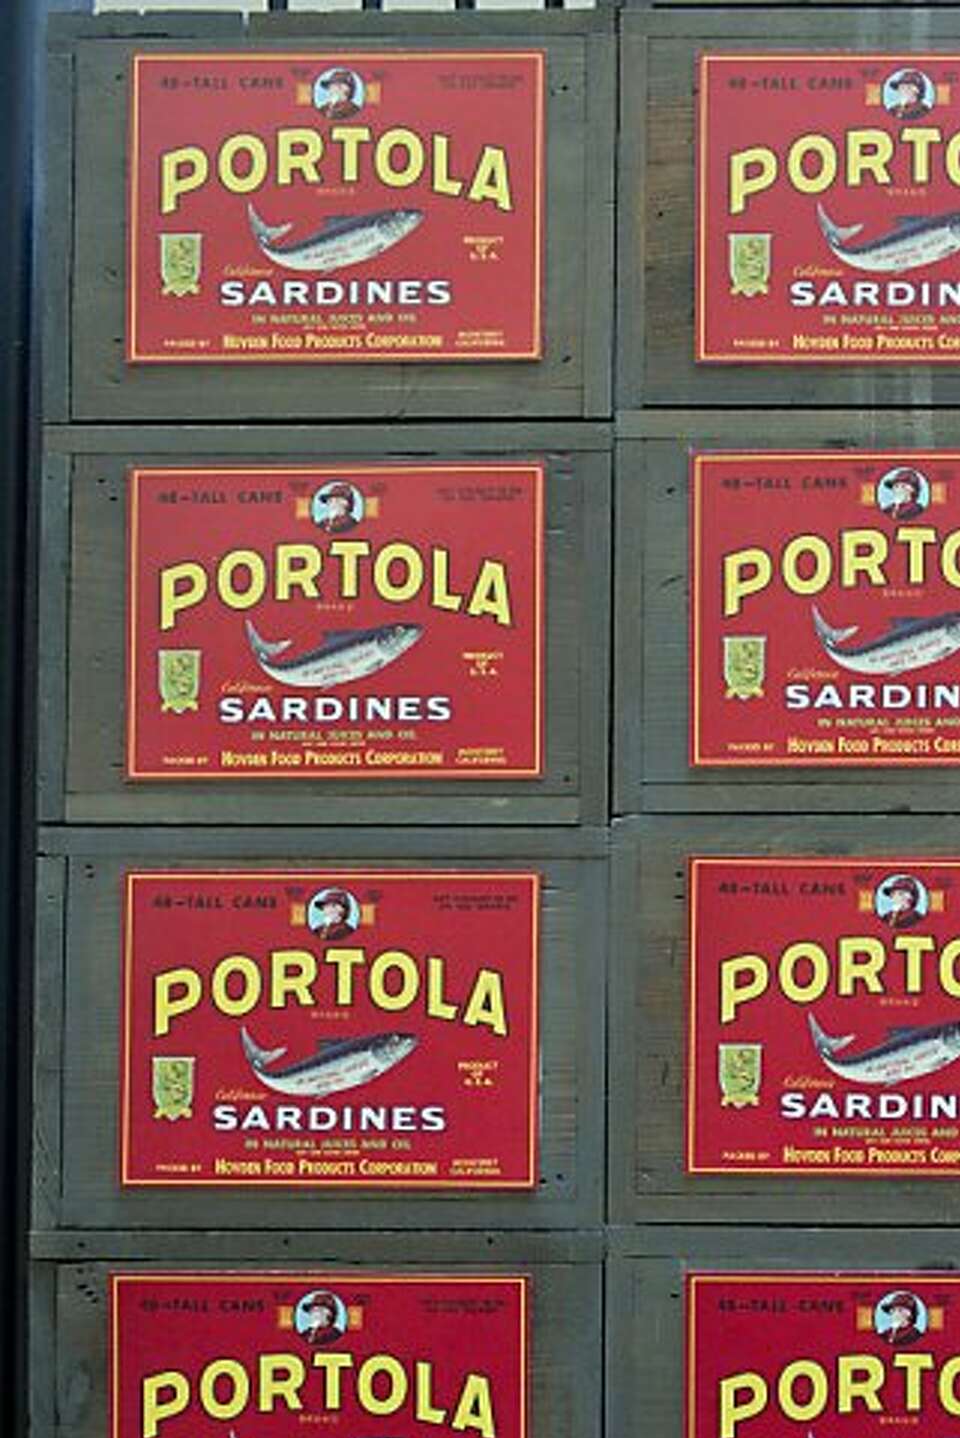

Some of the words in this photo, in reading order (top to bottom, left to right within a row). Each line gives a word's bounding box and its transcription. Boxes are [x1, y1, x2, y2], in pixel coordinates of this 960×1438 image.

[161, 126, 513, 215] PORTOLA
[220, 278, 452, 307] SARDINES
[271, 333, 303, 349] FOOD
[842, 334, 874, 349] FOOD
[877, 333, 934, 349] PRODUCTS
[160, 541, 513, 631] PORTOLA
[219, 694, 451, 724] SARDINES
[837, 737, 869, 753] FOOD
[872, 736, 930, 752] PRODUCTS
[270, 750, 302, 766] FOOD
[305, 749, 361, 765] PRODUCTS
[365, 748, 443, 764] CORPORATION
[153, 947, 509, 1036] PORTOLA
[212, 1104, 446, 1131] SARDINES
[264, 1159, 296, 1174] FOOD
[298, 1159, 355, 1174] PRODUCTS
[359, 1158, 437, 1174] CORPORATION
[833, 1147, 865, 1163] FOOD
[868, 1147, 926, 1163] PRODUCTS
